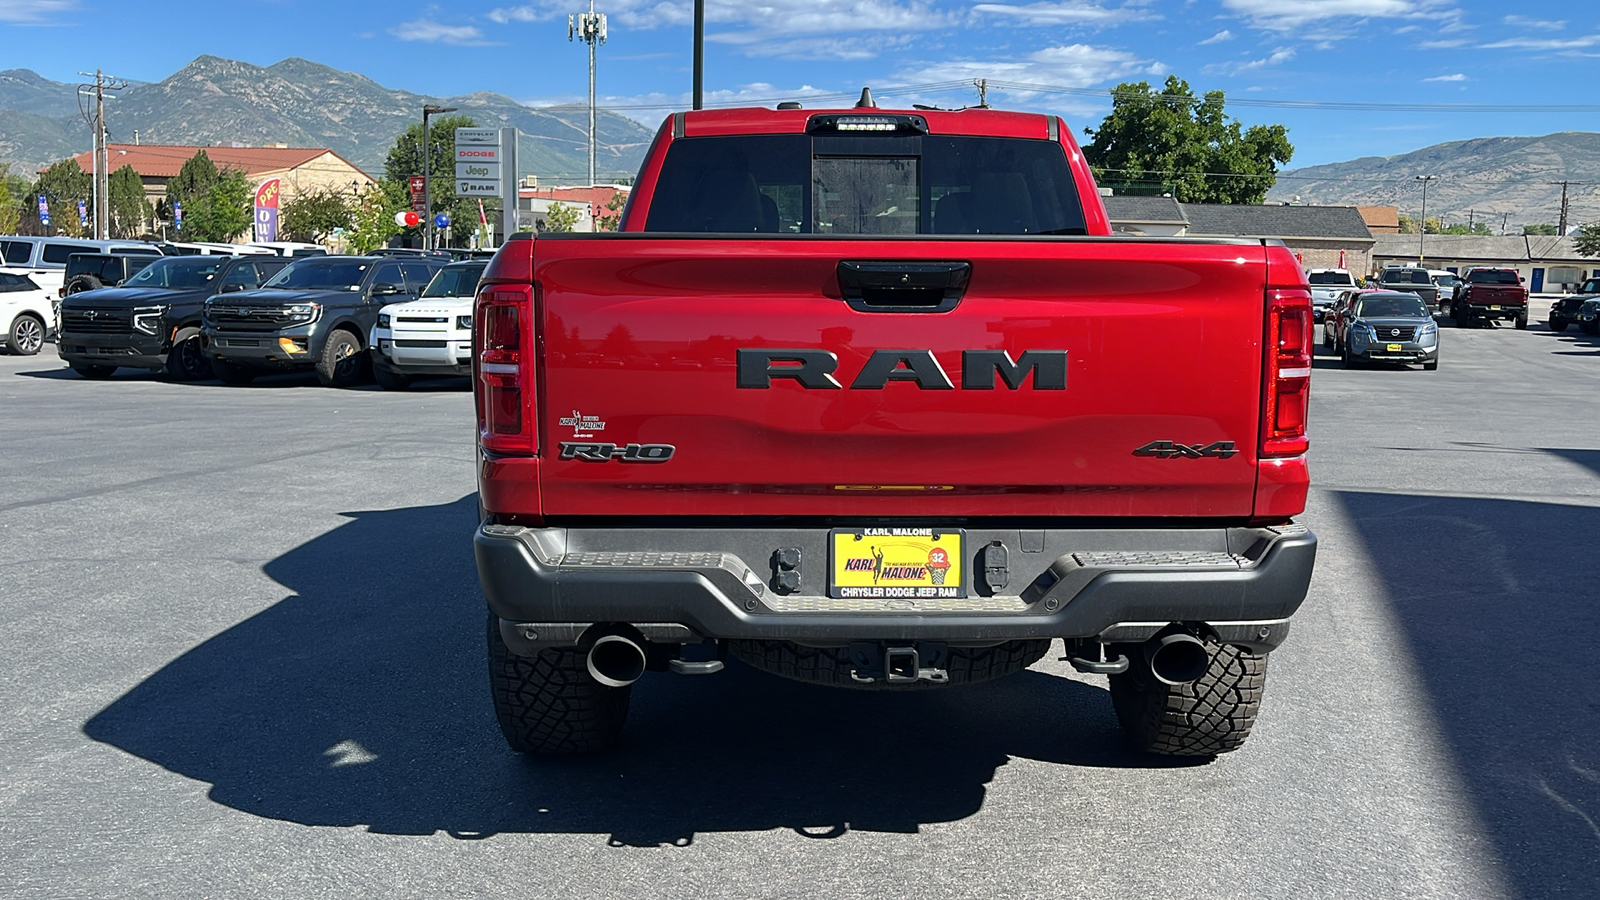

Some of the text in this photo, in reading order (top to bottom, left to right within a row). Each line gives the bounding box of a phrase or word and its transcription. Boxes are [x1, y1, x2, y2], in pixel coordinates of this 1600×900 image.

[466, 165, 489, 177] Jeep
[259, 182, 278, 206] PRE
[736, 348, 1069, 391] RAM
[558, 441, 676, 464] RHO
[864, 528, 932, 536] KARL MALONE
[931, 552, 944, 563] 32
[844, 558, 875, 572] KARL
[880, 566, 927, 580] MALONE
[840, 587, 957, 597] CHRYSLER DODGE JEEP RAM
